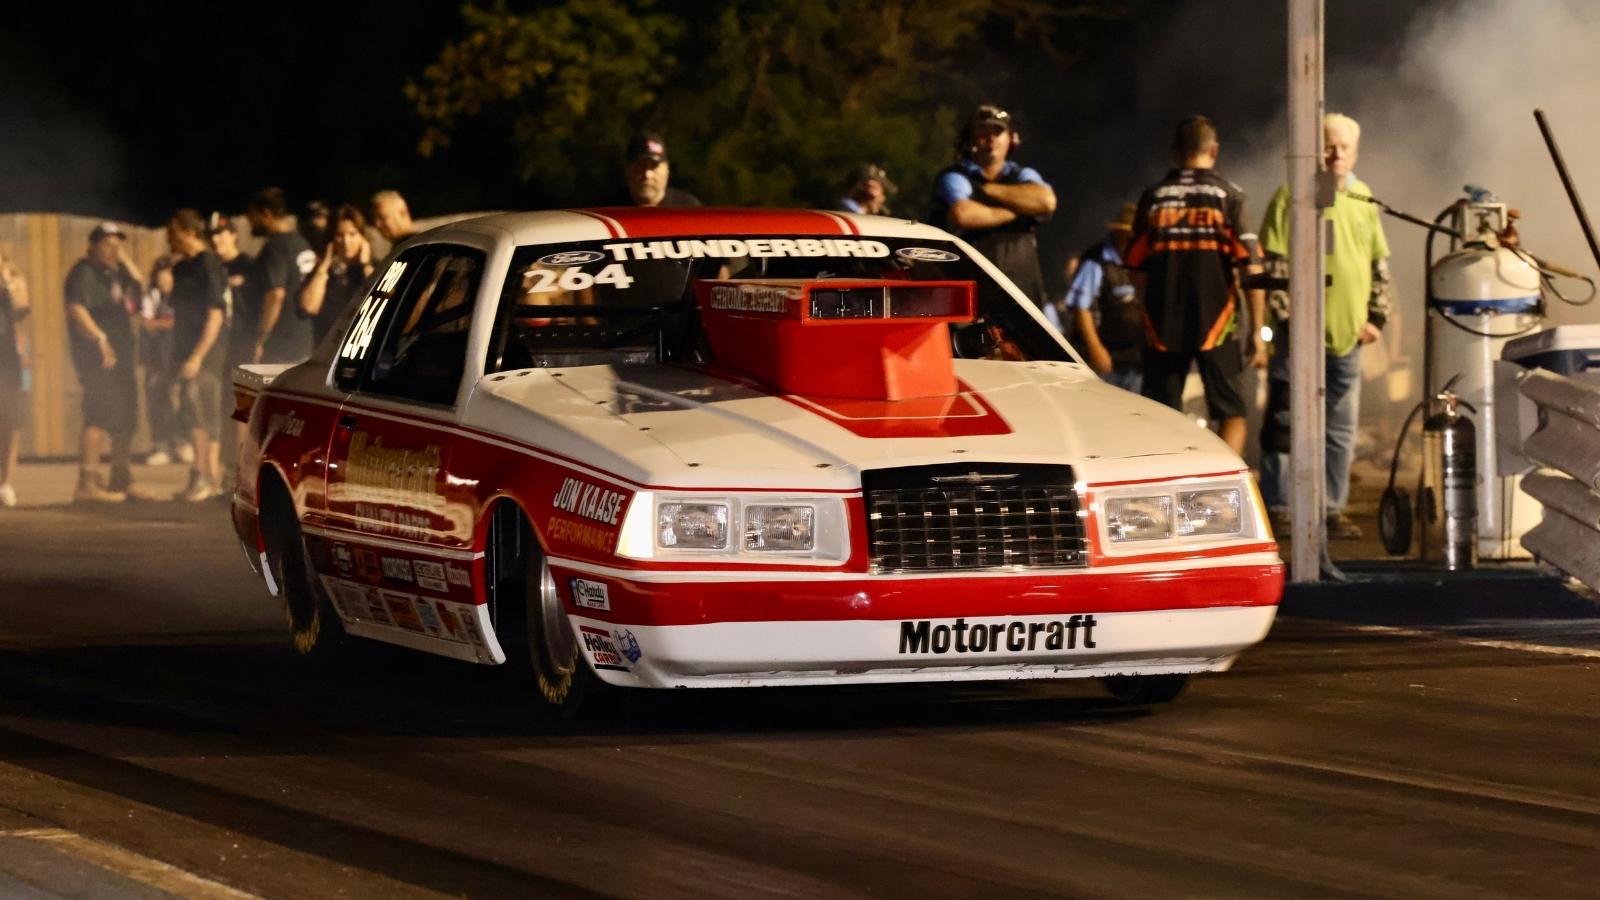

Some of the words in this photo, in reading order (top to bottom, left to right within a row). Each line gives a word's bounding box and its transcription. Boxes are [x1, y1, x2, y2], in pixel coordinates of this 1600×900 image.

[603, 240, 890, 260] THUNDERBIRD
[523, 265, 632, 293] 264
[341, 296, 388, 359] 264
[553, 477, 583, 512] JON
[578, 484, 626, 525] KAASE
[547, 516, 615, 553] PERFORMANCE
[900, 615, 1096, 653] Motorcraft
